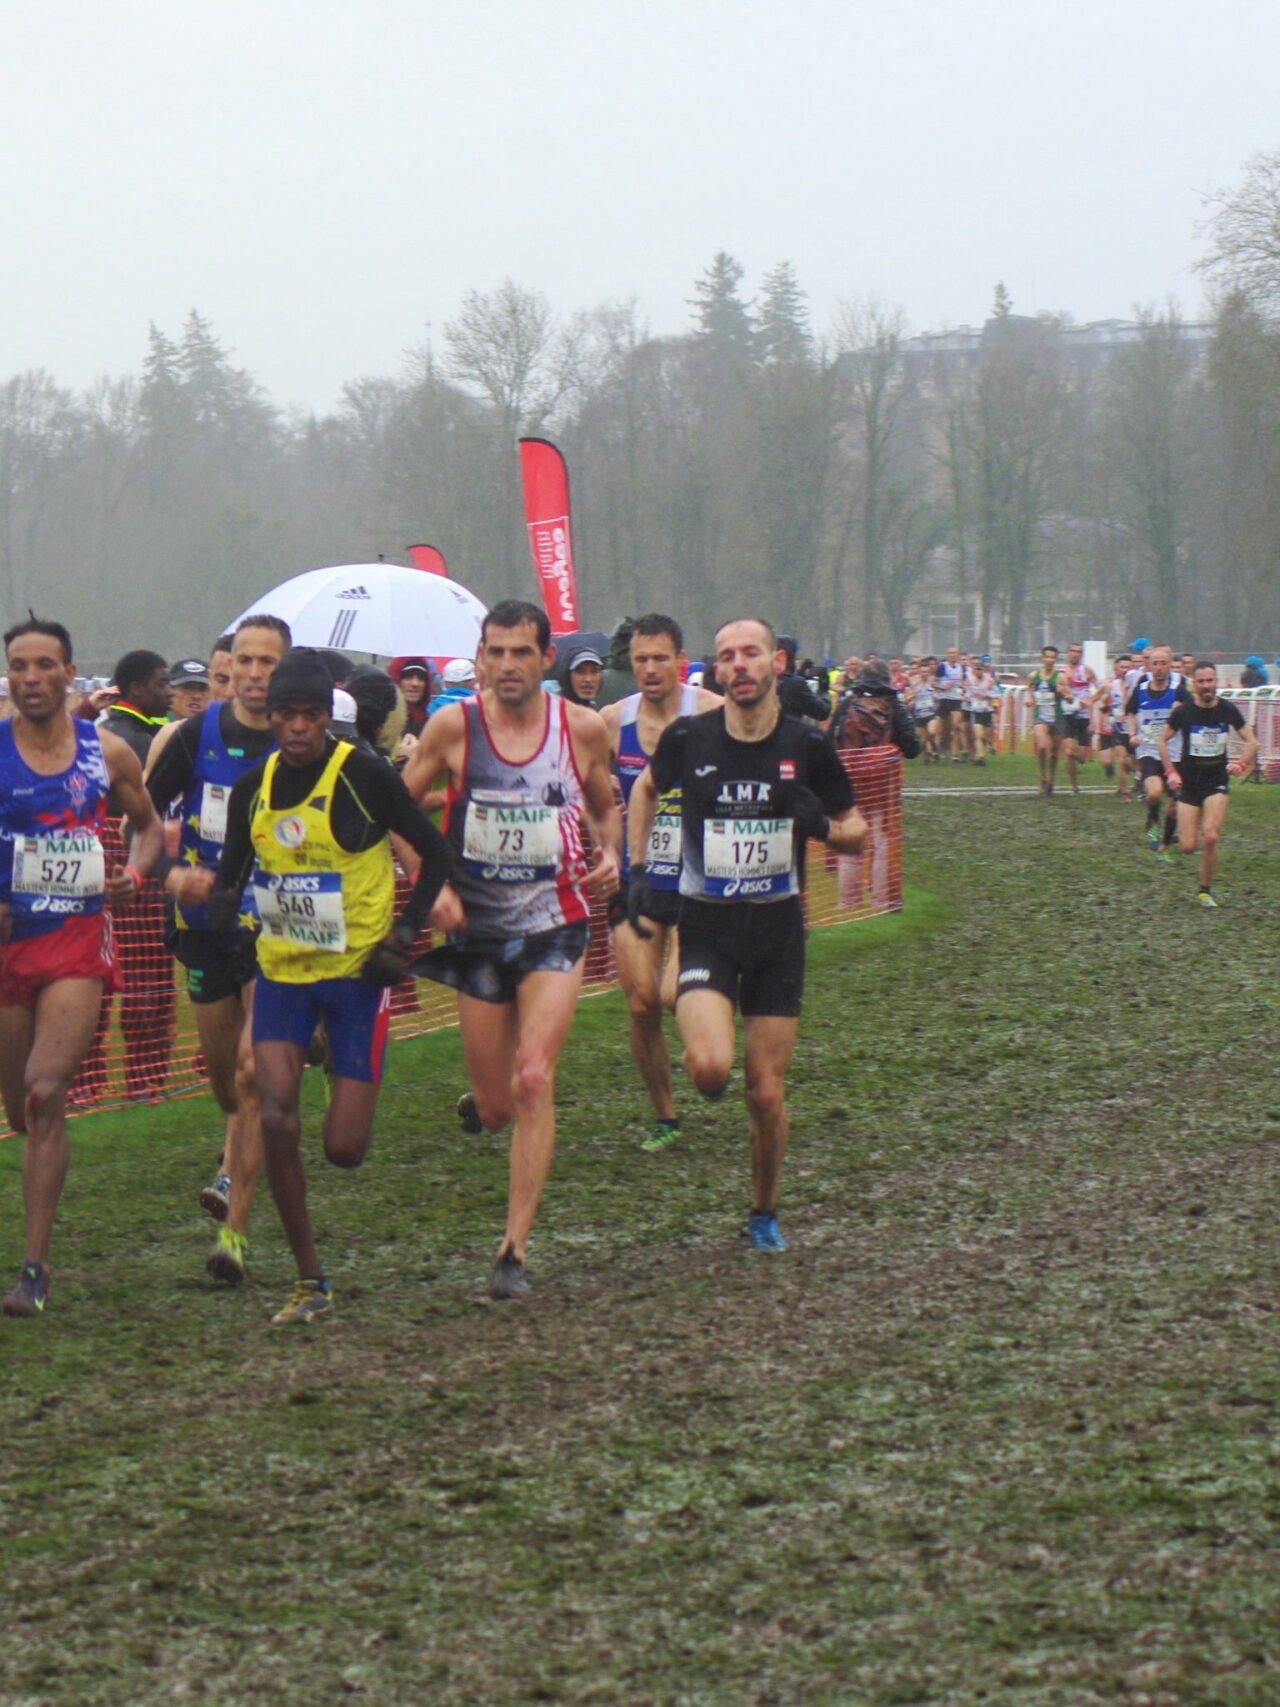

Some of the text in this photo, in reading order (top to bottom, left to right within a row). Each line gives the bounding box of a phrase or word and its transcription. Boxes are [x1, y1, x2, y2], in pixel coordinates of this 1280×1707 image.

[495, 808, 551, 823] MAIF
[654, 817, 680, 828] MAI
[733, 821, 789, 835] MAIF
[46, 838, 96, 854] MAIF
[498, 829, 524, 851] 73
[651, 831, 671, 851] 89
[731, 841, 768, 865] 175
[41, 859, 82, 884] 527
[283, 877, 320, 891] asics
[740, 879, 772, 893] asics
[49, 899, 86, 913] asics
[276, 894, 315, 918] 548
[288, 925, 340, 945] MAIF
